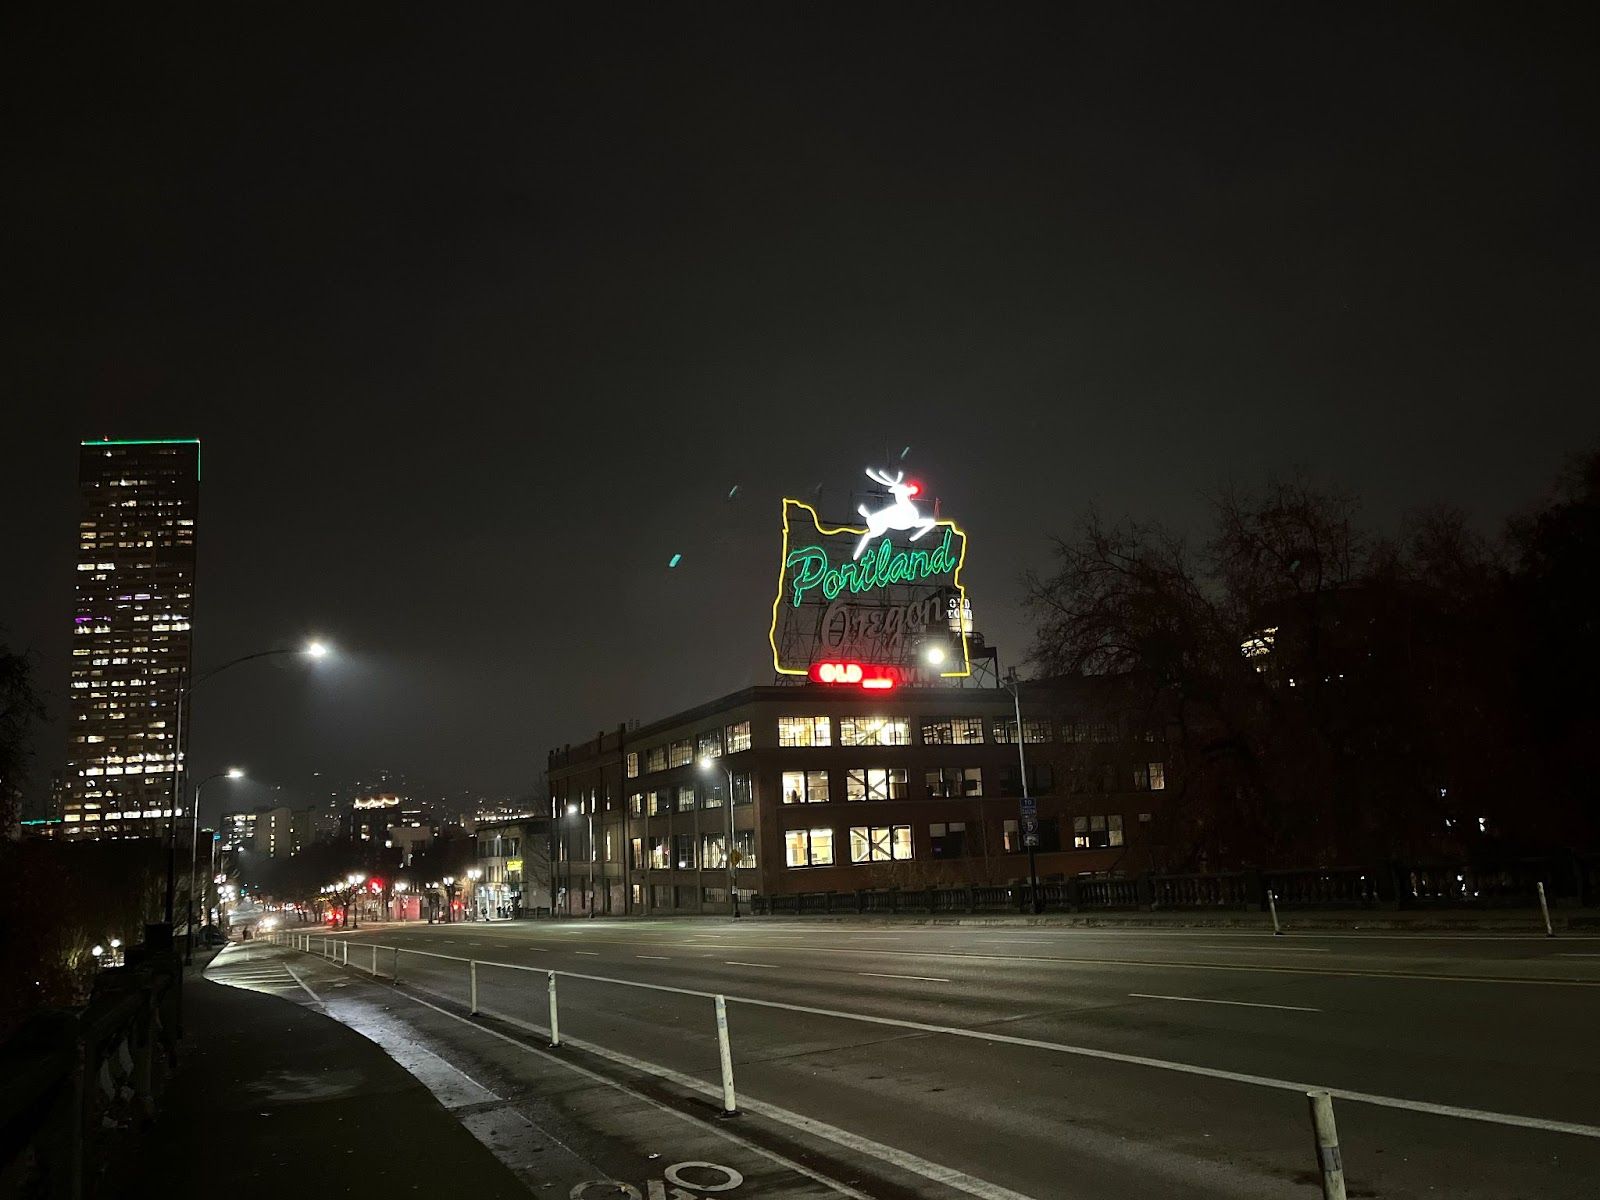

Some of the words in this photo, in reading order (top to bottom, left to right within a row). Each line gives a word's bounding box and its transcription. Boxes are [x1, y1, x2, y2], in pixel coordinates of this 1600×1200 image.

[787, 529, 955, 607] Portland
[820, 596, 946, 648] Oregon
[946, 608, 972, 620] TON
[819, 663, 863, 683] OLD
